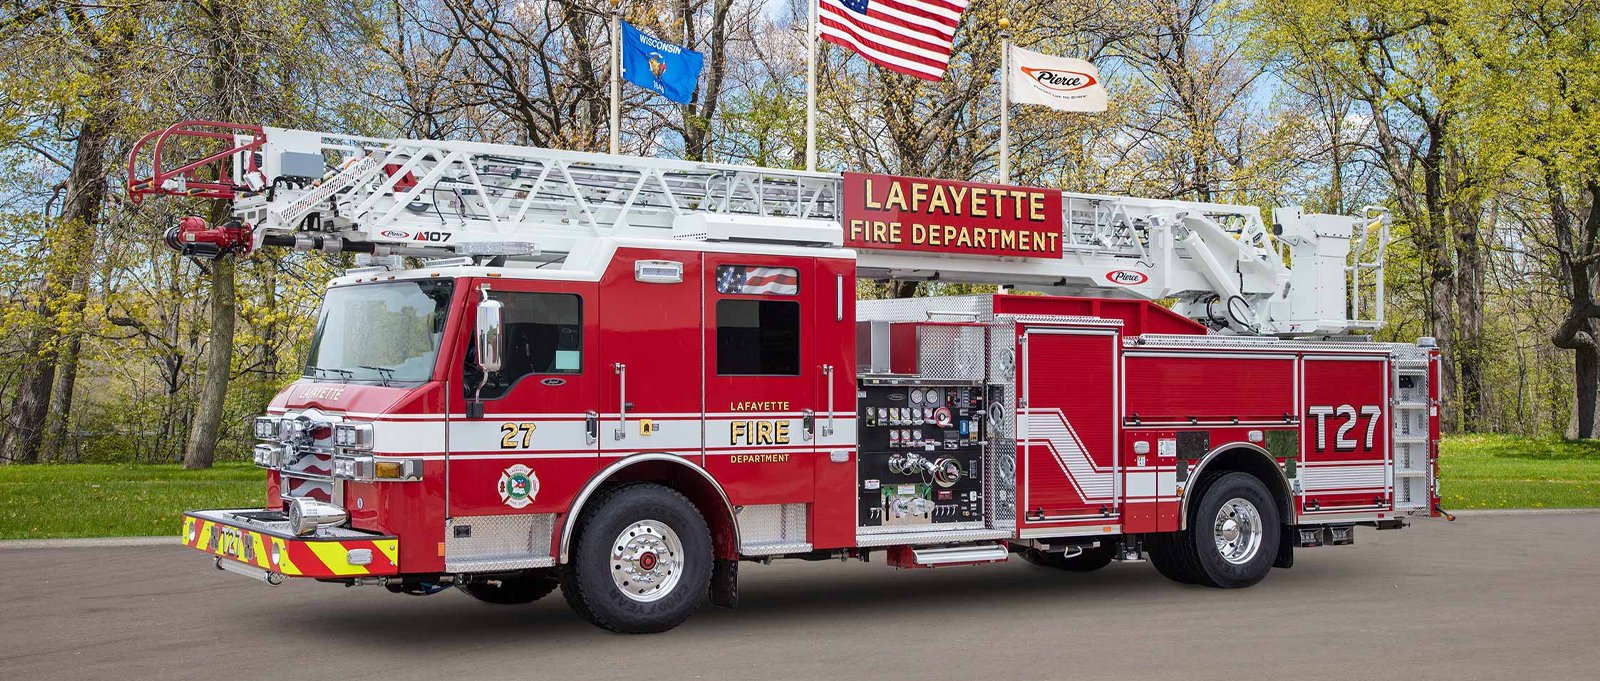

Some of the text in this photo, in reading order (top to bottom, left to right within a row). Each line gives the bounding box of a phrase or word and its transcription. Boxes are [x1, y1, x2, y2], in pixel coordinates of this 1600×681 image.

[640, 35, 681, 54] WISCONSIN
[1038, 71, 1080, 86] Pierce
[864, 179, 1045, 222] LAFAYETTE
[850, 219, 1058, 252] FIRE DEPARTMENT
[1115, 271, 1139, 282] Pierce
[299, 387, 344, 400] LAFAYETTE
[730, 401, 790, 411] LAFAYETTE
[501, 422, 536, 449] 27
[731, 420, 790, 445] FIRE
[1306, 404, 1381, 452] T27
[730, 453, 790, 464] DEPARTMENT
[222, 527, 243, 557] T27
